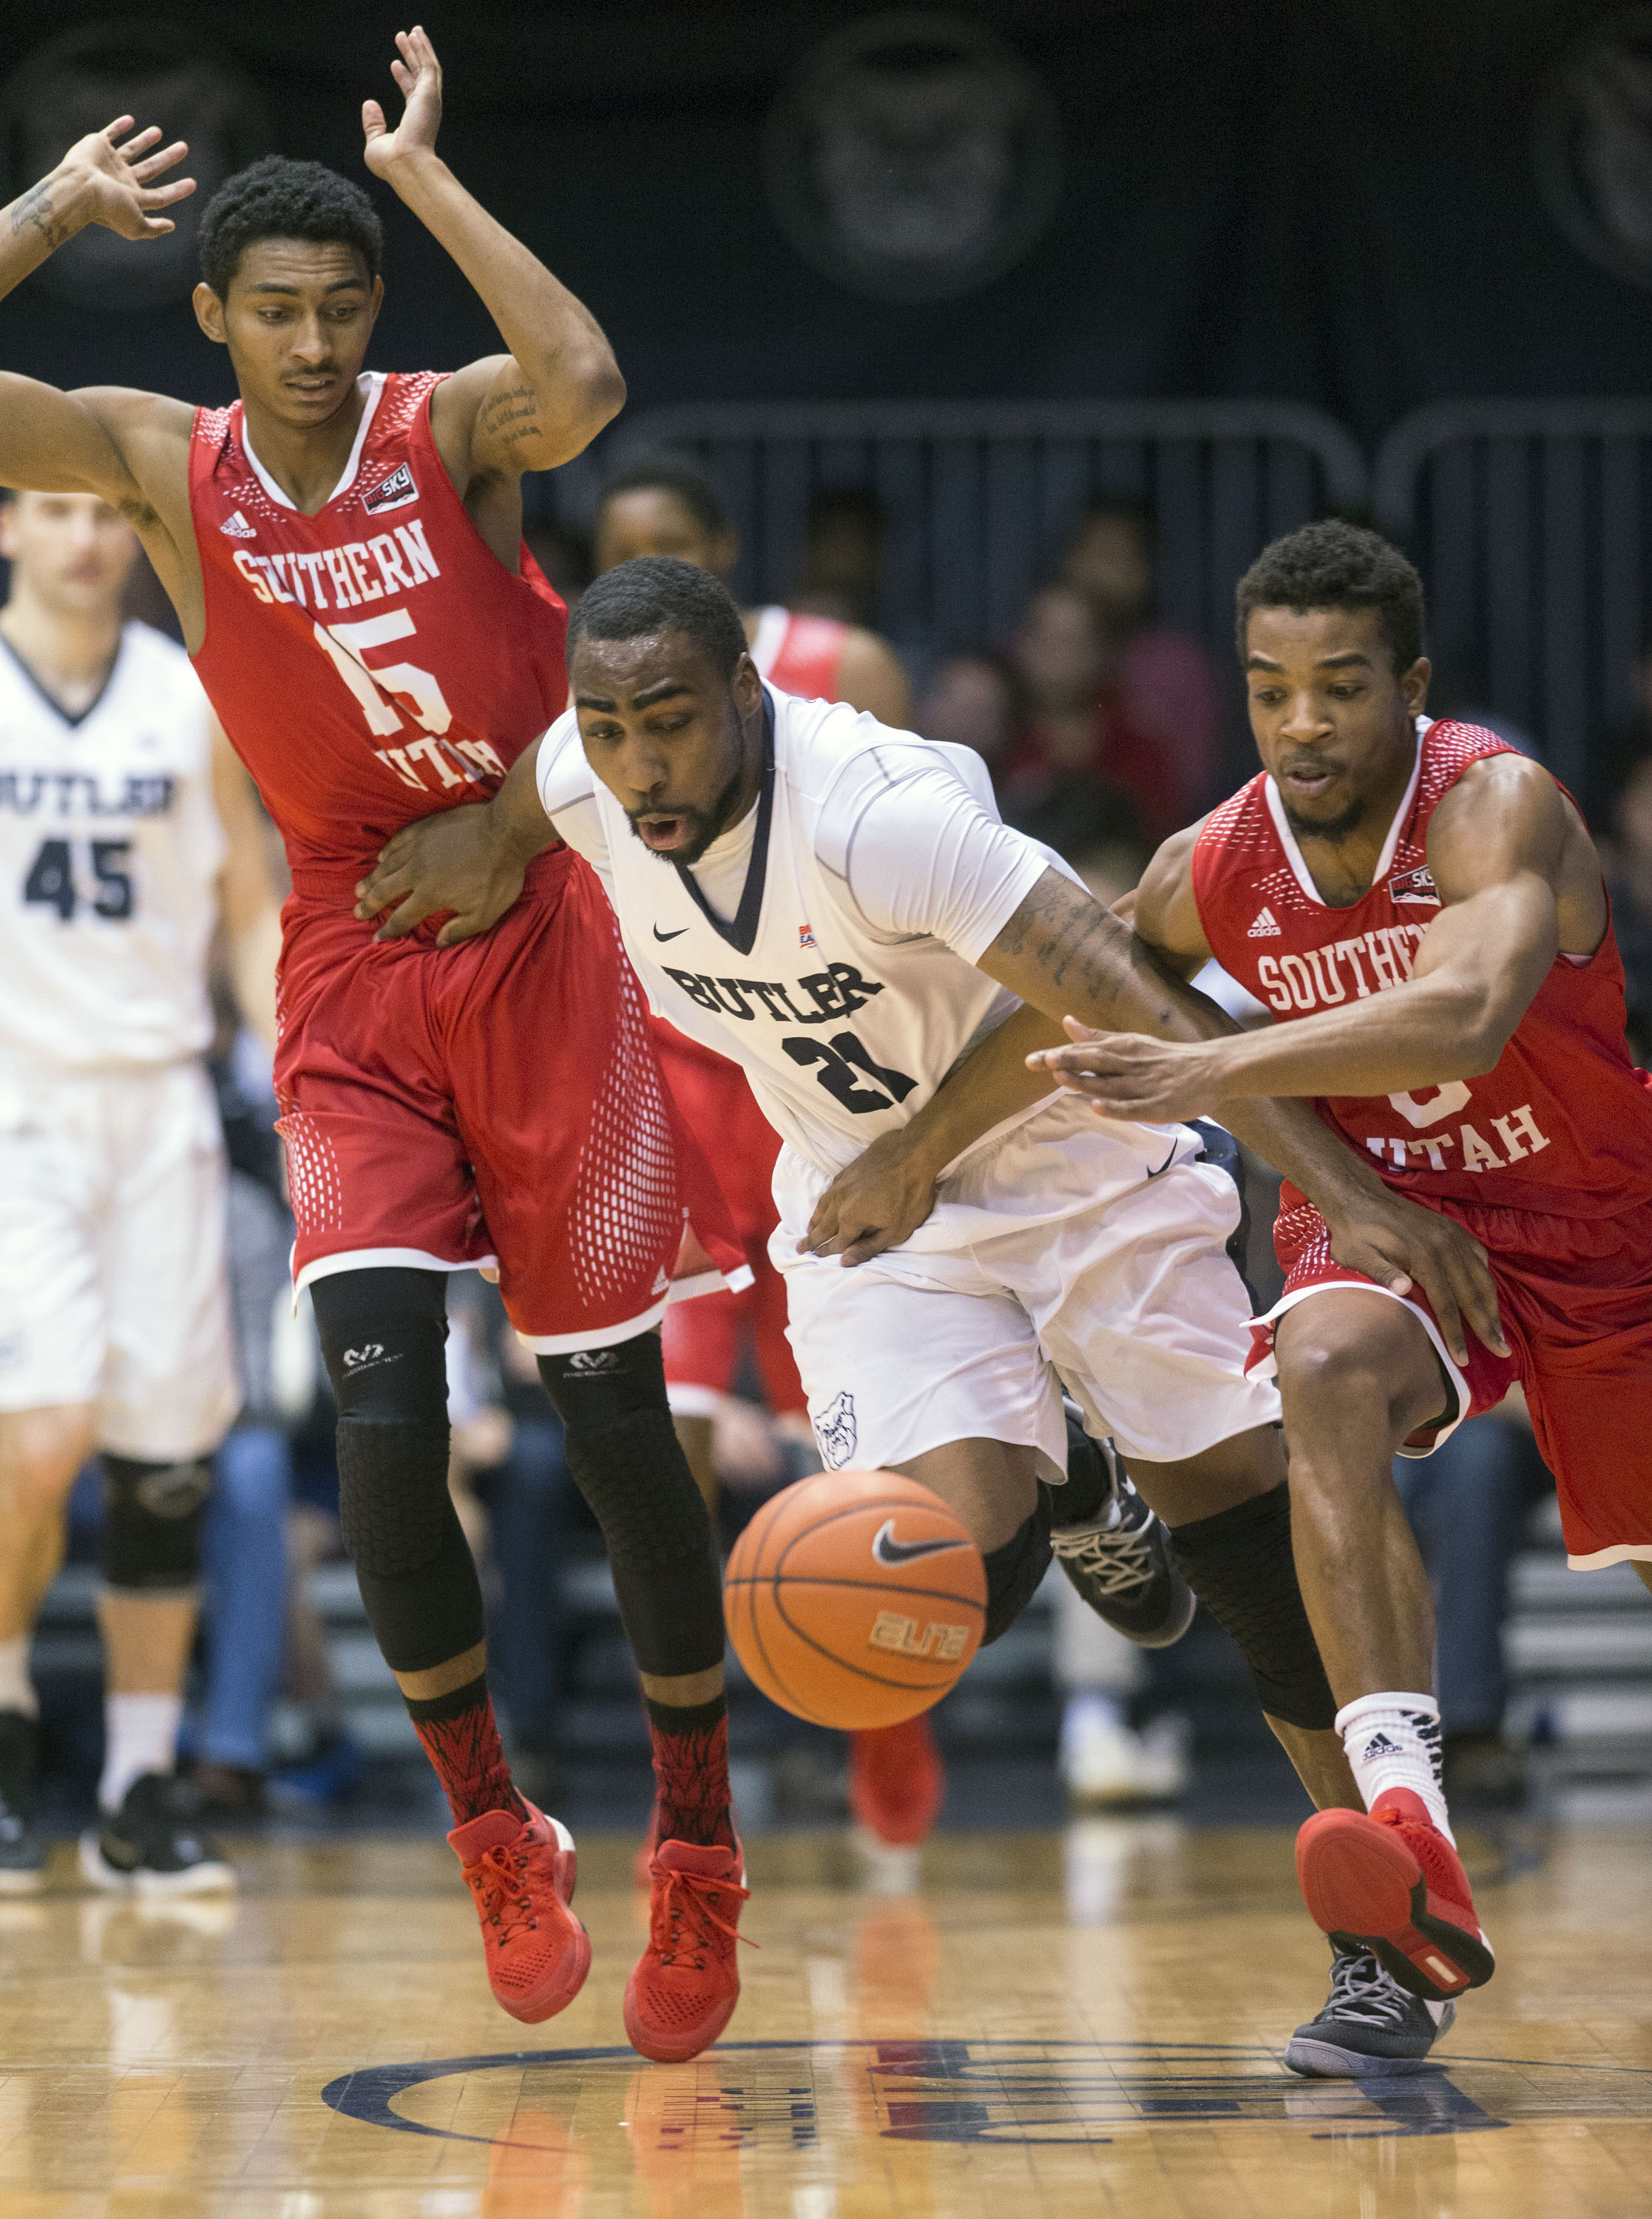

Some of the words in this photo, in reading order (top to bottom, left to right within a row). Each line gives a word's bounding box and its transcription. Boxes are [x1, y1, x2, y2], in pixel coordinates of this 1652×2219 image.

[382, 467, 410, 496] SKY
[220, 526, 257, 538] adidas
[233, 519, 440, 609] SOUTHERN
[314, 608, 453, 736] 15
[24, 838, 134, 923] 45
[1247, 926, 1282, 937] adidas
[660, 962, 885, 1024] BUTLER
[1258, 922, 1431, 1010] SOUTHE
[782, 1031, 918, 1114] 21
[1367, 1104, 1550, 1172] UTAH
[1363, 1744, 1403, 1761] adidas
